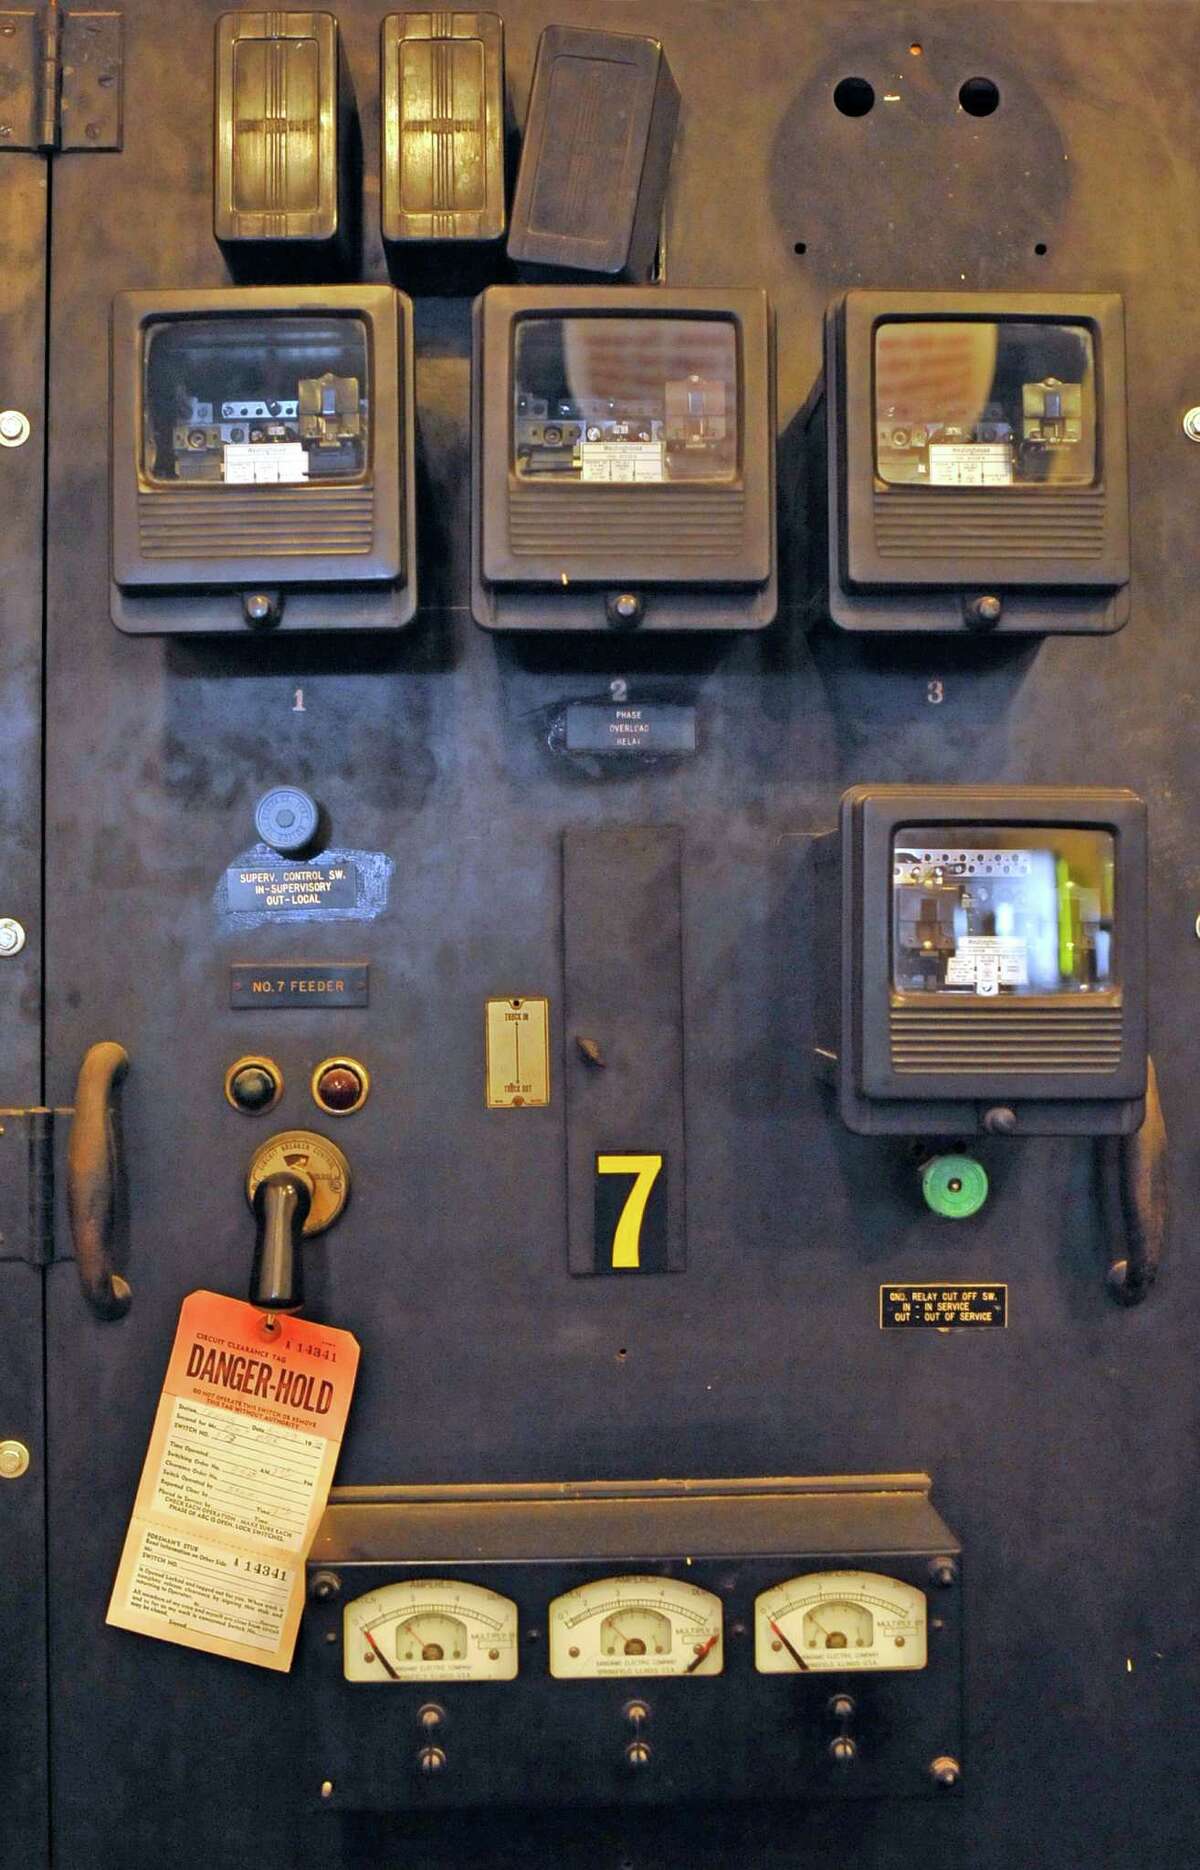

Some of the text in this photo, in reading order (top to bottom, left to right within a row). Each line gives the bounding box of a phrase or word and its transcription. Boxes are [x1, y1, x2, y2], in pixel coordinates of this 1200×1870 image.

[292, 689, 306, 711] 1
[610, 679, 627, 701] 2
[928, 680, 943, 703] 3
[616, 711, 642, 720] PHASE
[283, 871, 323, 882] CONTROL
[329, 869, 347, 880] SW.
[290, 980, 344, 993] FEEDER
[598, 1155, 662, 1268] 7
[902, 1303, 911, 1311] IN
[924, 1303, 933, 1311] IN
[937, 1302, 970, 1311] SERVICE
[912, 1292, 937, 1301] RELAY
[942, 1292, 958, 1301] CUT
[962, 1292, 977, 1301] OFF
[894, 1313, 911, 1322] OUT
[924, 1312, 940, 1322] OUT
[945, 1312, 956, 1321] OF
[959, 1312, 993, 1321] SERVICE
[196, 1332, 286, 1363] CIRCUIT CLEARANCE TAG
[184, 1343, 335, 1415] DANGER-HOLD
[244, 1560, 288, 1581] 14341
